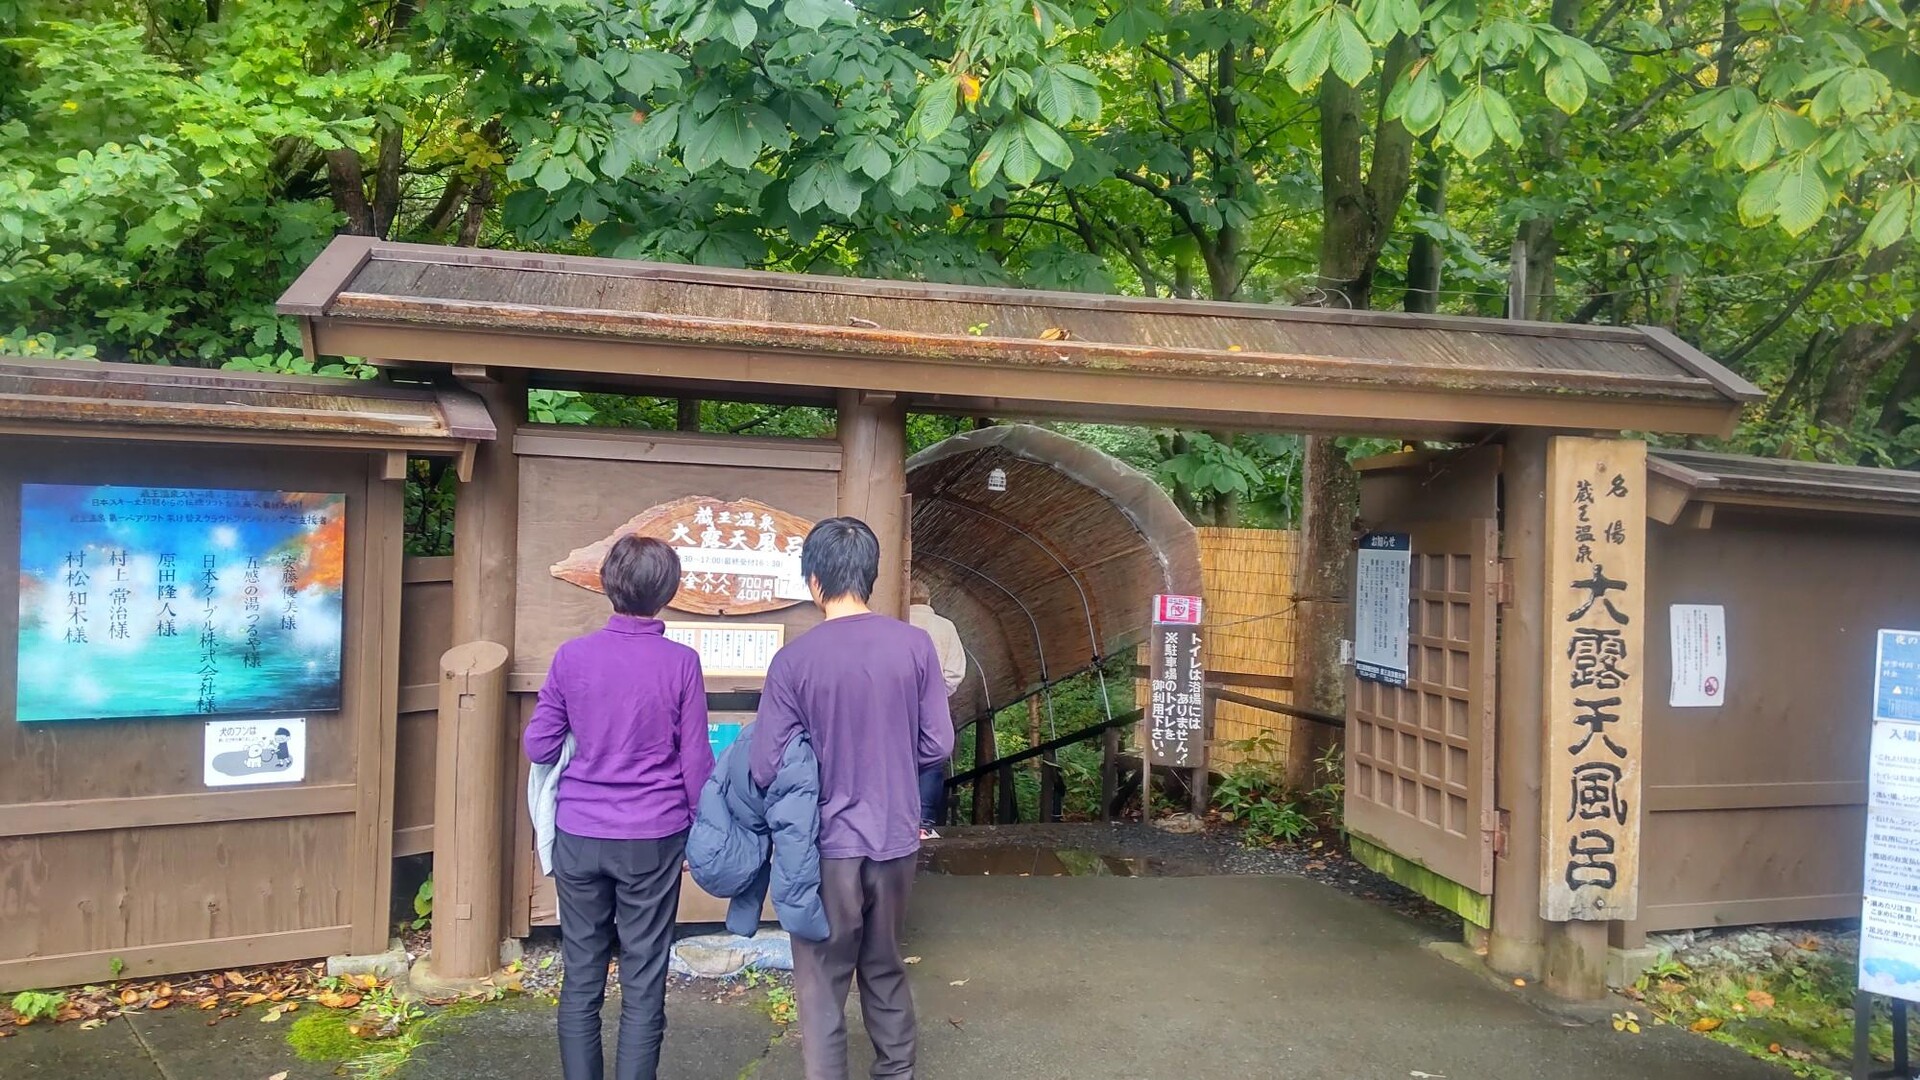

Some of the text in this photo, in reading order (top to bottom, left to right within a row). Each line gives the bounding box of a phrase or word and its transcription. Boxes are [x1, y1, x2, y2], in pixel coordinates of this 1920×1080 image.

[668, 523, 804, 555] 大露天風呂
[693, 506, 777, 533] 蔵王温泉
[1371, 536, 1396, 548] お知らせ
[1573, 480, 1596, 564] 蔵王温泉
[680, 571, 773, 590] 金 大人 700円
[701, 582, 772, 602] 小人 400円
[195, 554, 219, 713] 日本ケーブル株式会社様
[243, 556, 262, 669] 五感の湯つるや様
[1188, 632, 1202, 730] トイレは浴場には
[219, 726, 257, 738] 犬のフンは
[1151, 680, 1165, 757] 御利用下さい。
[1565, 565, 1630, 890] 大露天風呂
